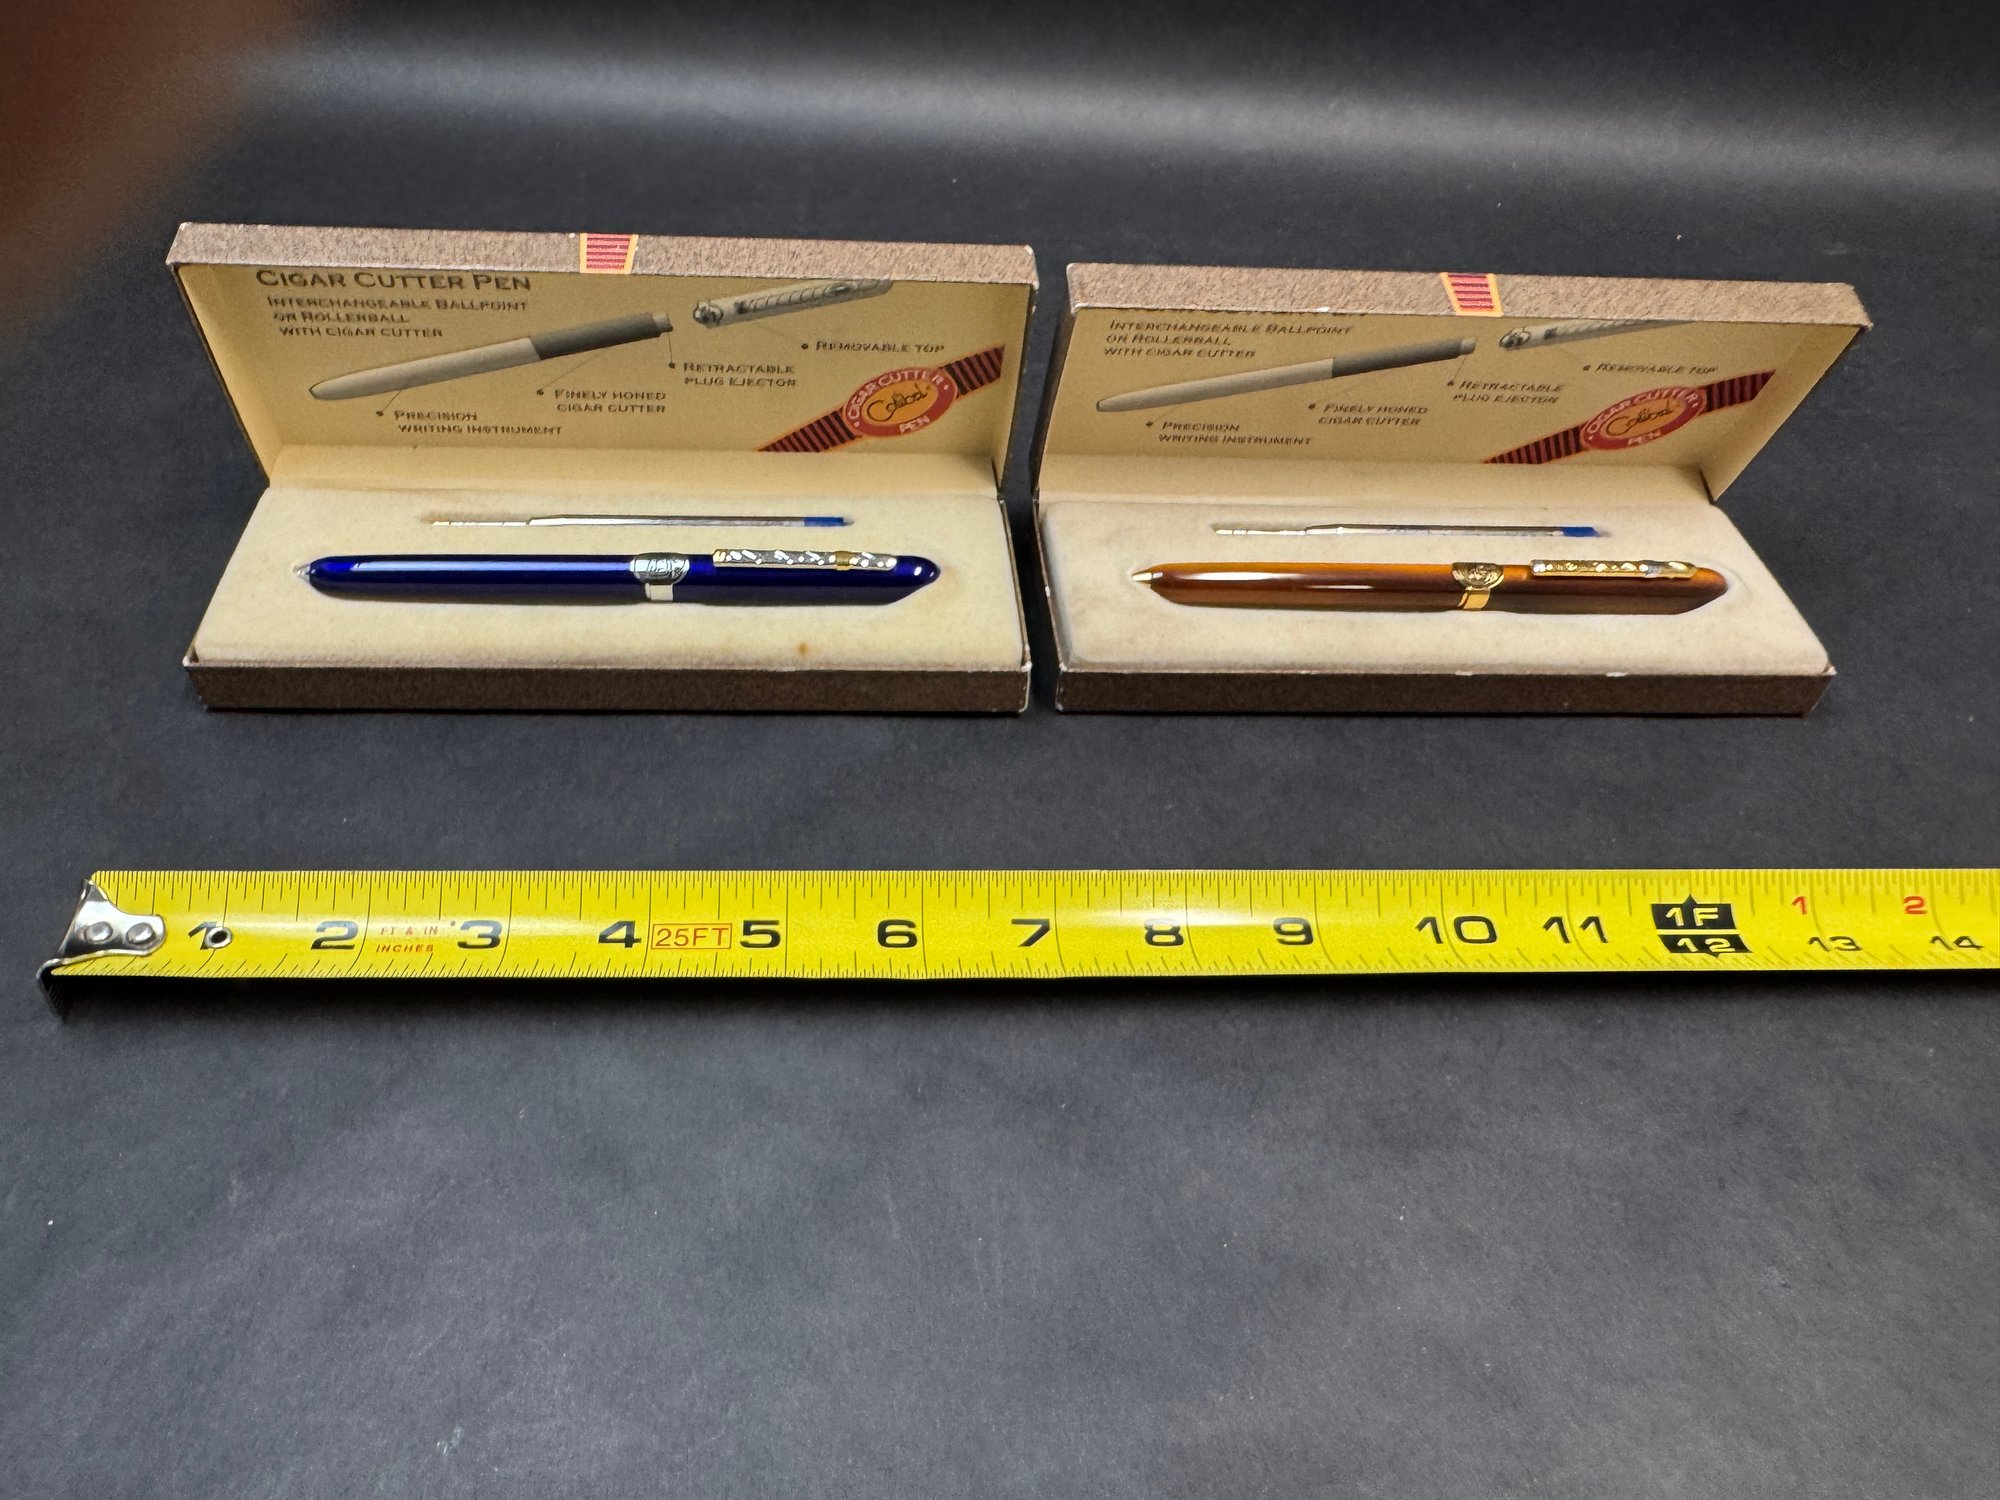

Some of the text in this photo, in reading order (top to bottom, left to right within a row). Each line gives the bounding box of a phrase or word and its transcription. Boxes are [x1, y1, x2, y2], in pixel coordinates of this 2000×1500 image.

[256, 269, 531, 291] CIGAR CUTTER PEN
[268, 296, 527, 311] INTERCHANGEABLE BALLPOINT
[273, 312, 409, 323] OR ROLLERBALL
[279, 327, 443, 338] WITH CIGAR CUTTER
[1264, 323, 1352, 335] BALLPOINT
[815, 340, 945, 353] REMOVABLE TOP
[683, 362, 796, 374] RETRACTABLE
[729, 377, 797, 387] EJECTOR
[612, 390, 667, 401] HONED
[394, 410, 478, 421] PRECISION
[556, 403, 666, 413] CIGAR CUTTER
[397, 425, 562, 435] WRITING INSTRUMENT
[1791, 896, 1808, 915] 1
[1903, 896, 1927, 915] 2
[1665, 907, 1720, 927] 1F
[311, 920, 358, 950] 2
[457, 920, 502, 949] 3
[598, 920, 642, 949] 4
[656, 926, 730, 948] 25FT
[739, 920, 782, 949] 5
[877, 919, 918, 948] 6
[1011, 918, 1051, 948] 7
[1143, 916, 1186, 947] 8
[1272, 916, 1316, 946] 9
[1415, 915, 1499, 944] 10
[1543, 915, 1609, 944] 11
[376, 944, 434, 953] INCHES
[1676, 937, 1736, 953] 12
[1808, 935, 1862, 951] 13
[1929, 935, 1983, 951] 14
